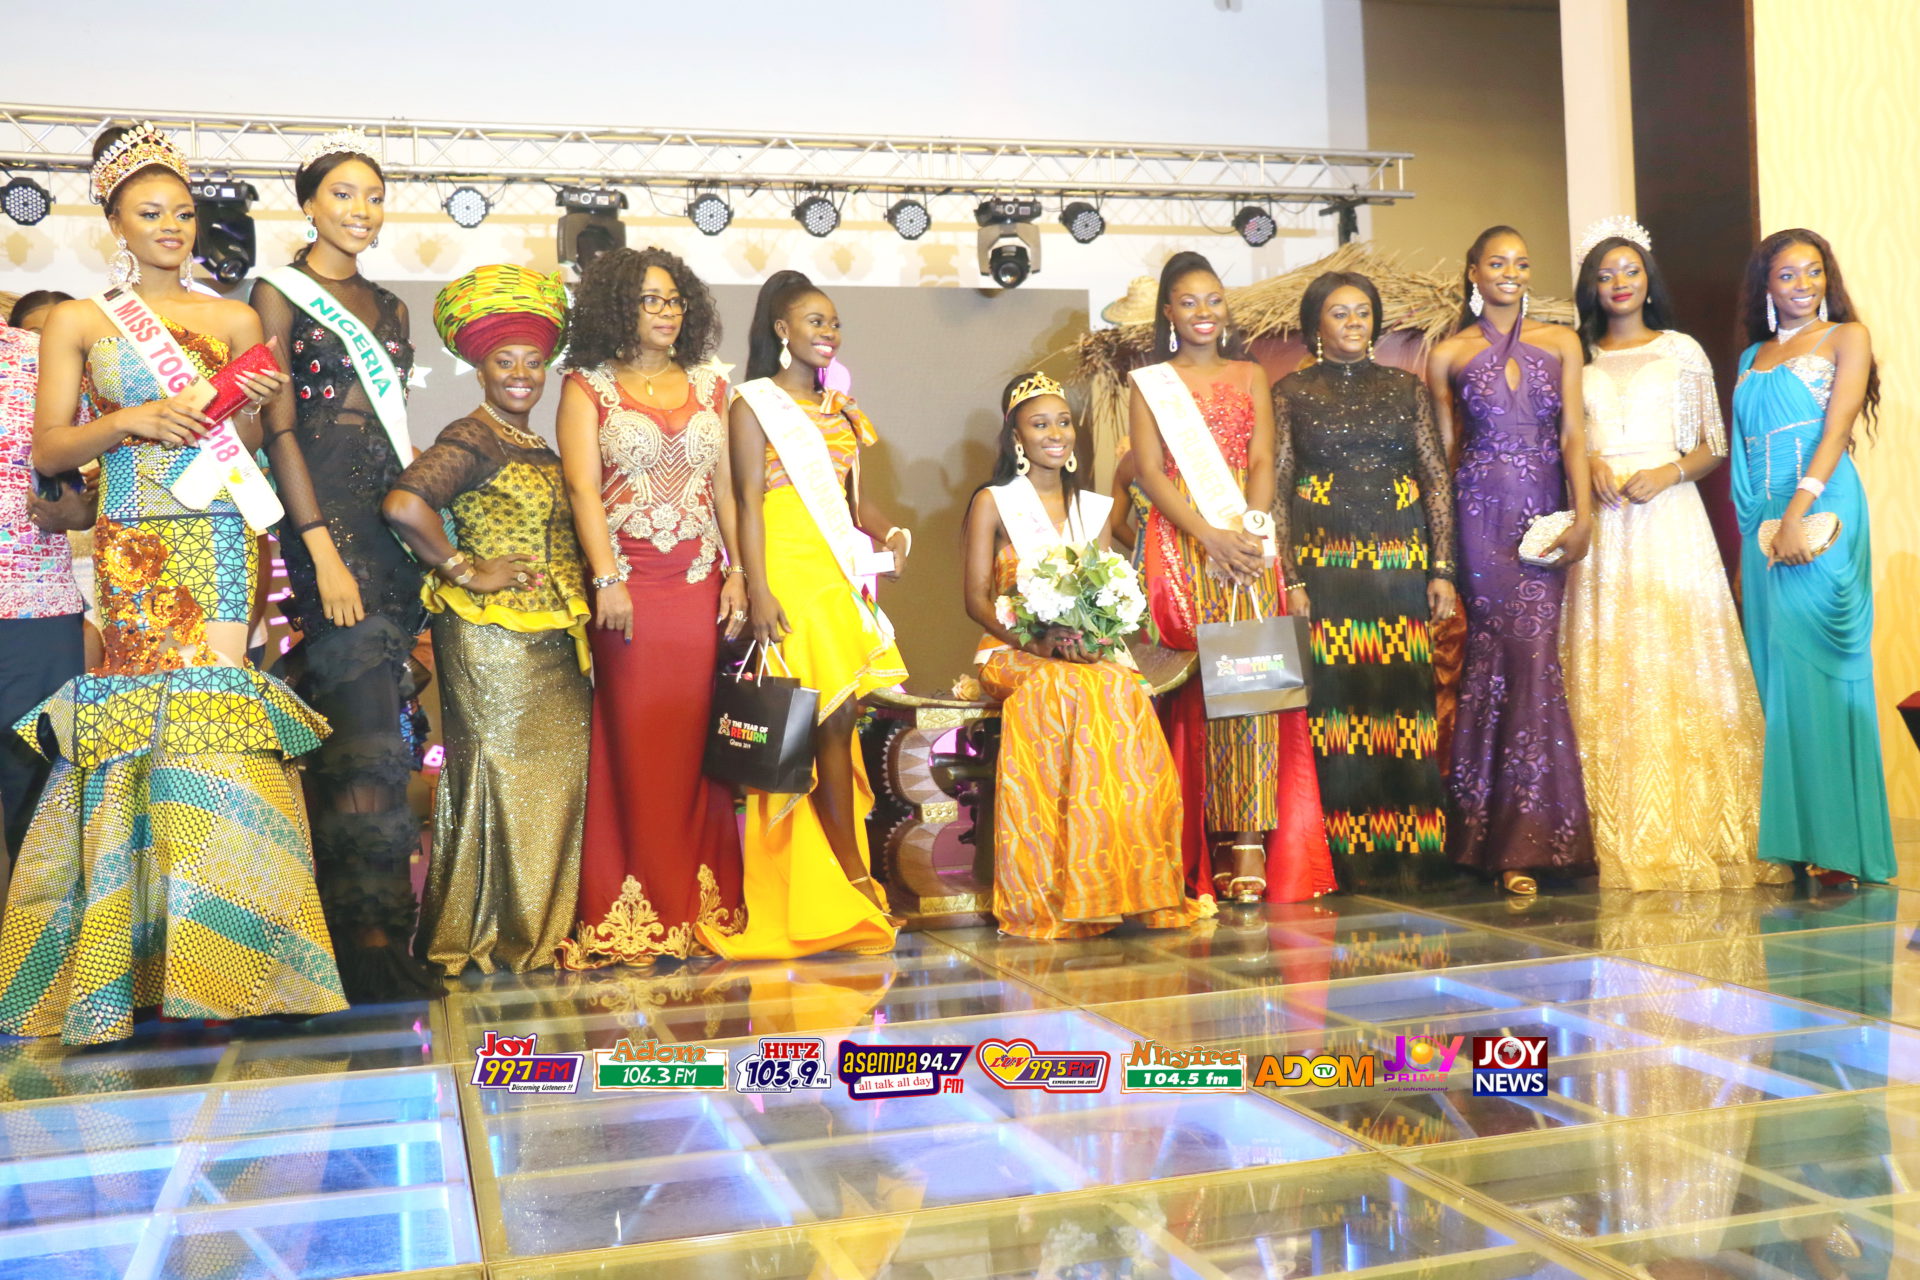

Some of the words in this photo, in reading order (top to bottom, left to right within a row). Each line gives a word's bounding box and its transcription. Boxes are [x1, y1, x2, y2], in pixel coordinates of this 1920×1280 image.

[113, 299, 161, 343] MISS
[149, 341, 193, 394] TOG
[308, 297, 392, 399] NIGERIA
[730, 727, 768, 744] RETURN
[743, 722, 758, 731] YEAR
